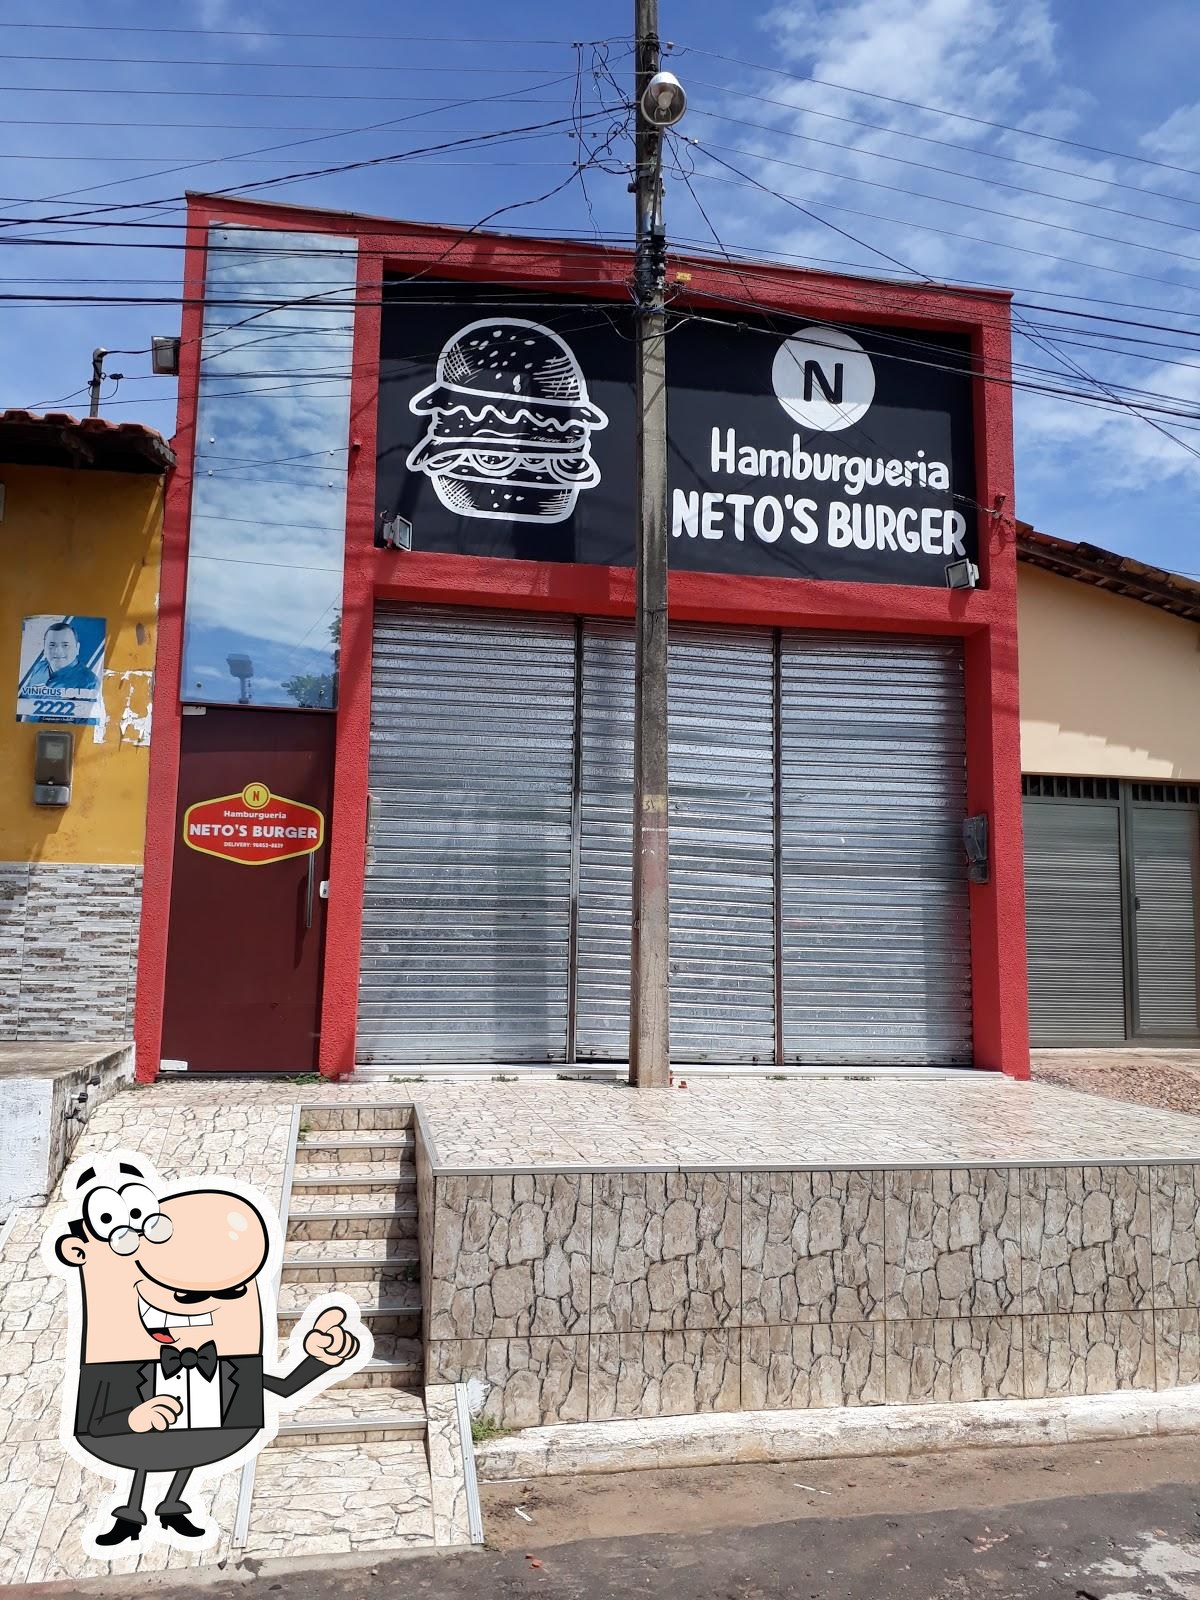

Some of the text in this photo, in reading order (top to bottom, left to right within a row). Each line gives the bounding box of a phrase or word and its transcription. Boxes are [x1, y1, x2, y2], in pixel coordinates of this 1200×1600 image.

[803, 359, 845, 405] N
[711, 427, 949, 495] Hamburgueria
[671, 488, 967, 556] NETO'S BURGER
[33, 700, 75, 715] 2222
[252, 790, 260, 802] N
[223, 810, 287, 820] Hamburgueria
[189, 823, 318, 839] NETO'S BURGER
